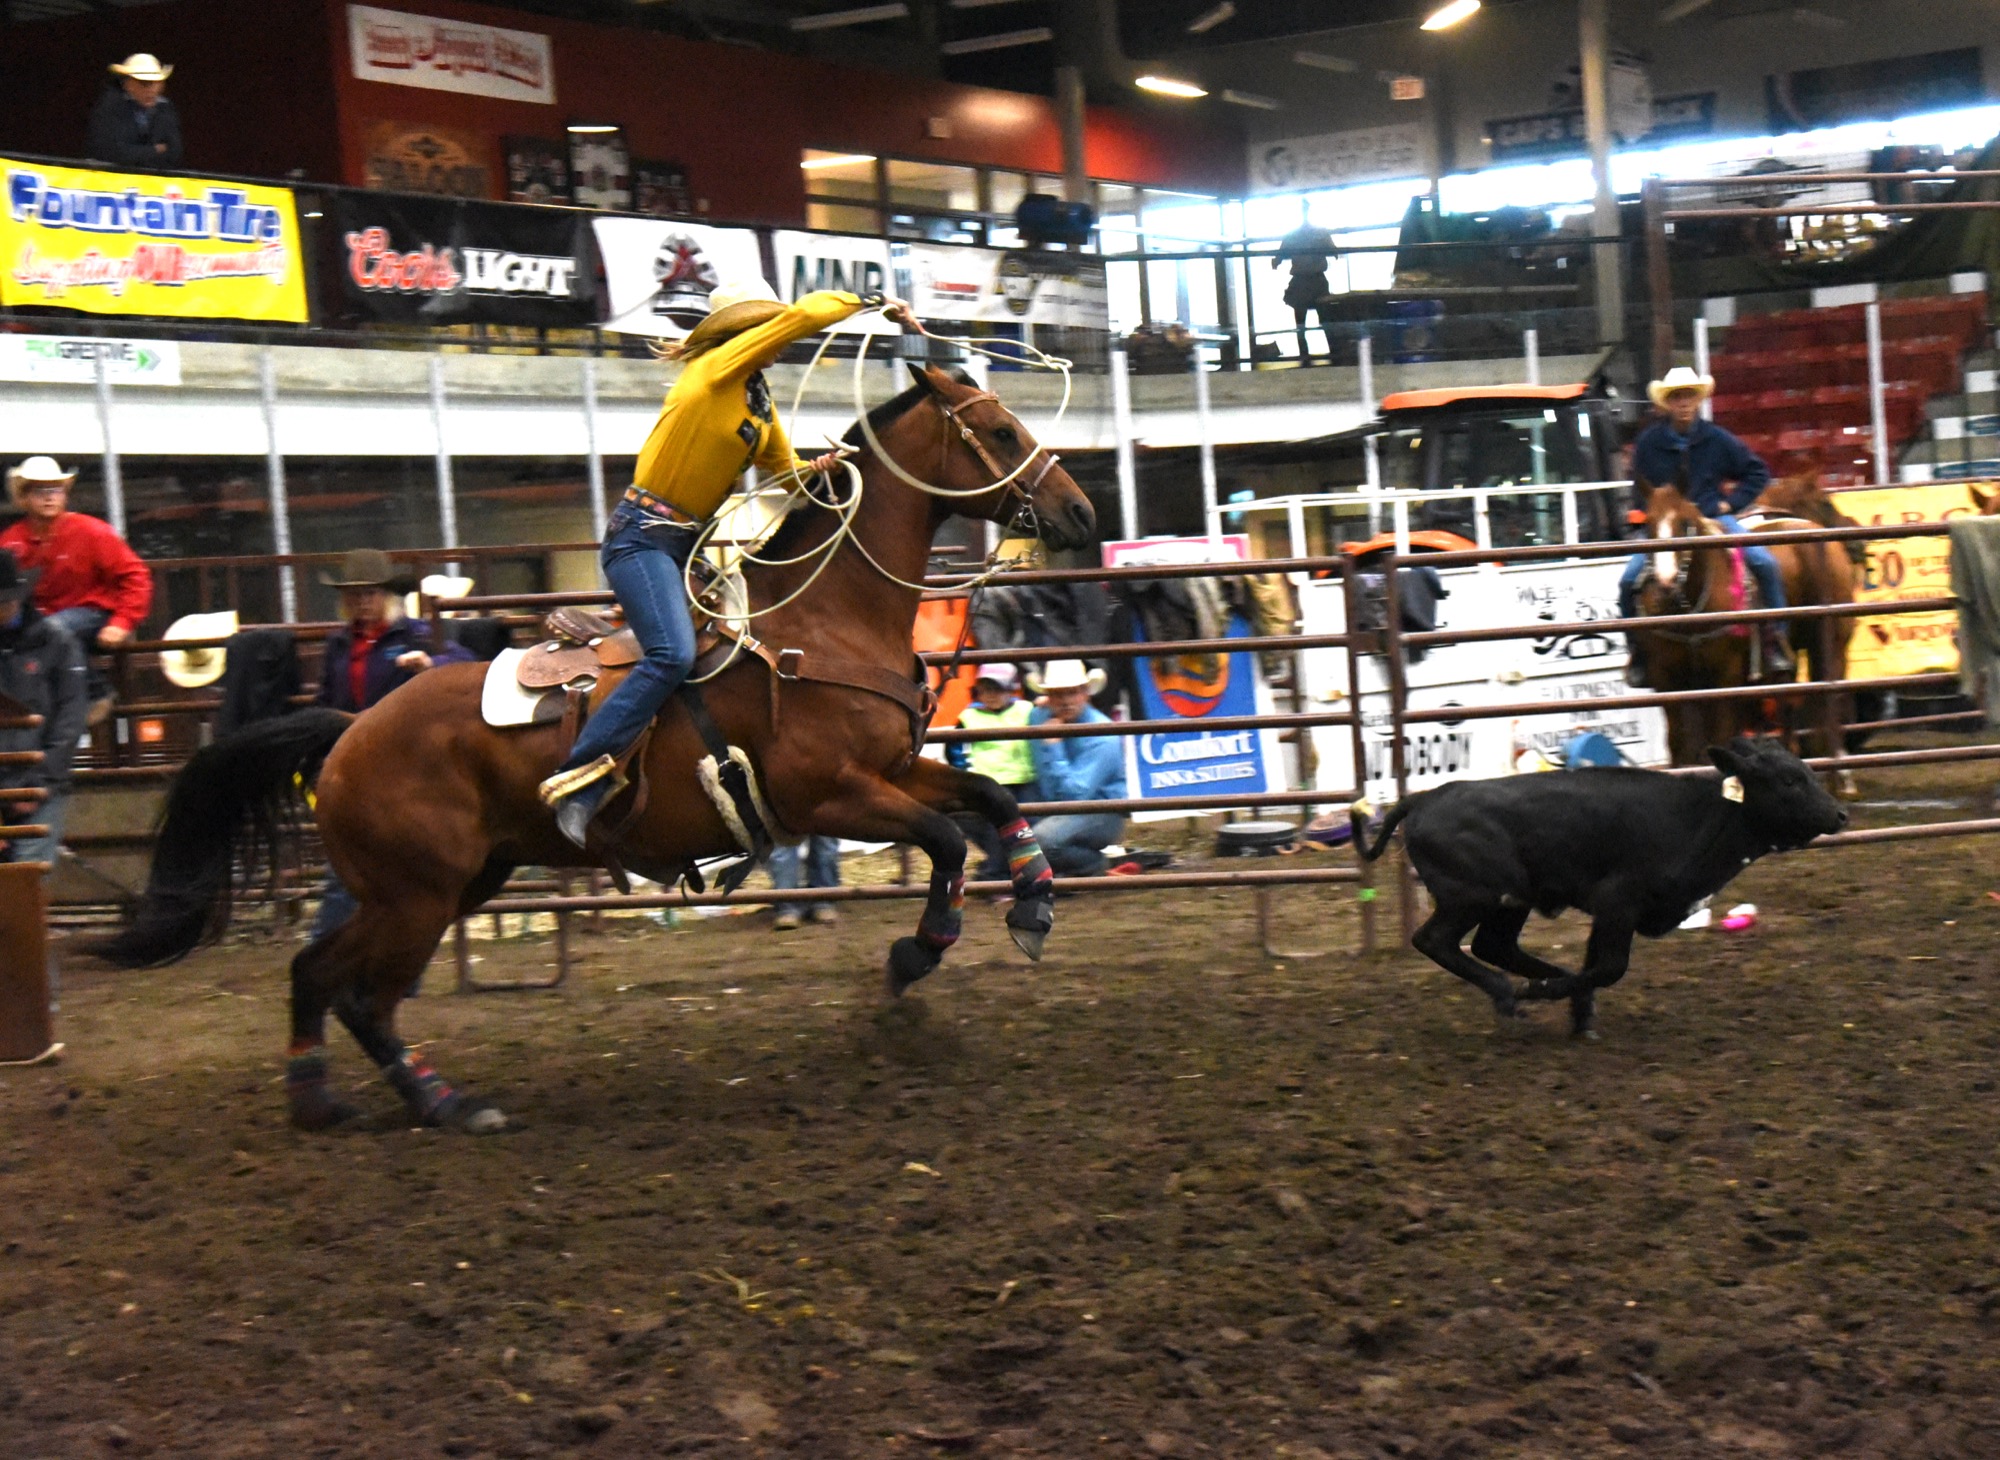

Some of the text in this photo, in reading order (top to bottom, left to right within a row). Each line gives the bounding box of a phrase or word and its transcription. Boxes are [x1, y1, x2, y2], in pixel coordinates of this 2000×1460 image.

[8, 169, 281, 243] Fountain Tire
[345, 226, 577, 300] Coors LIGHT
